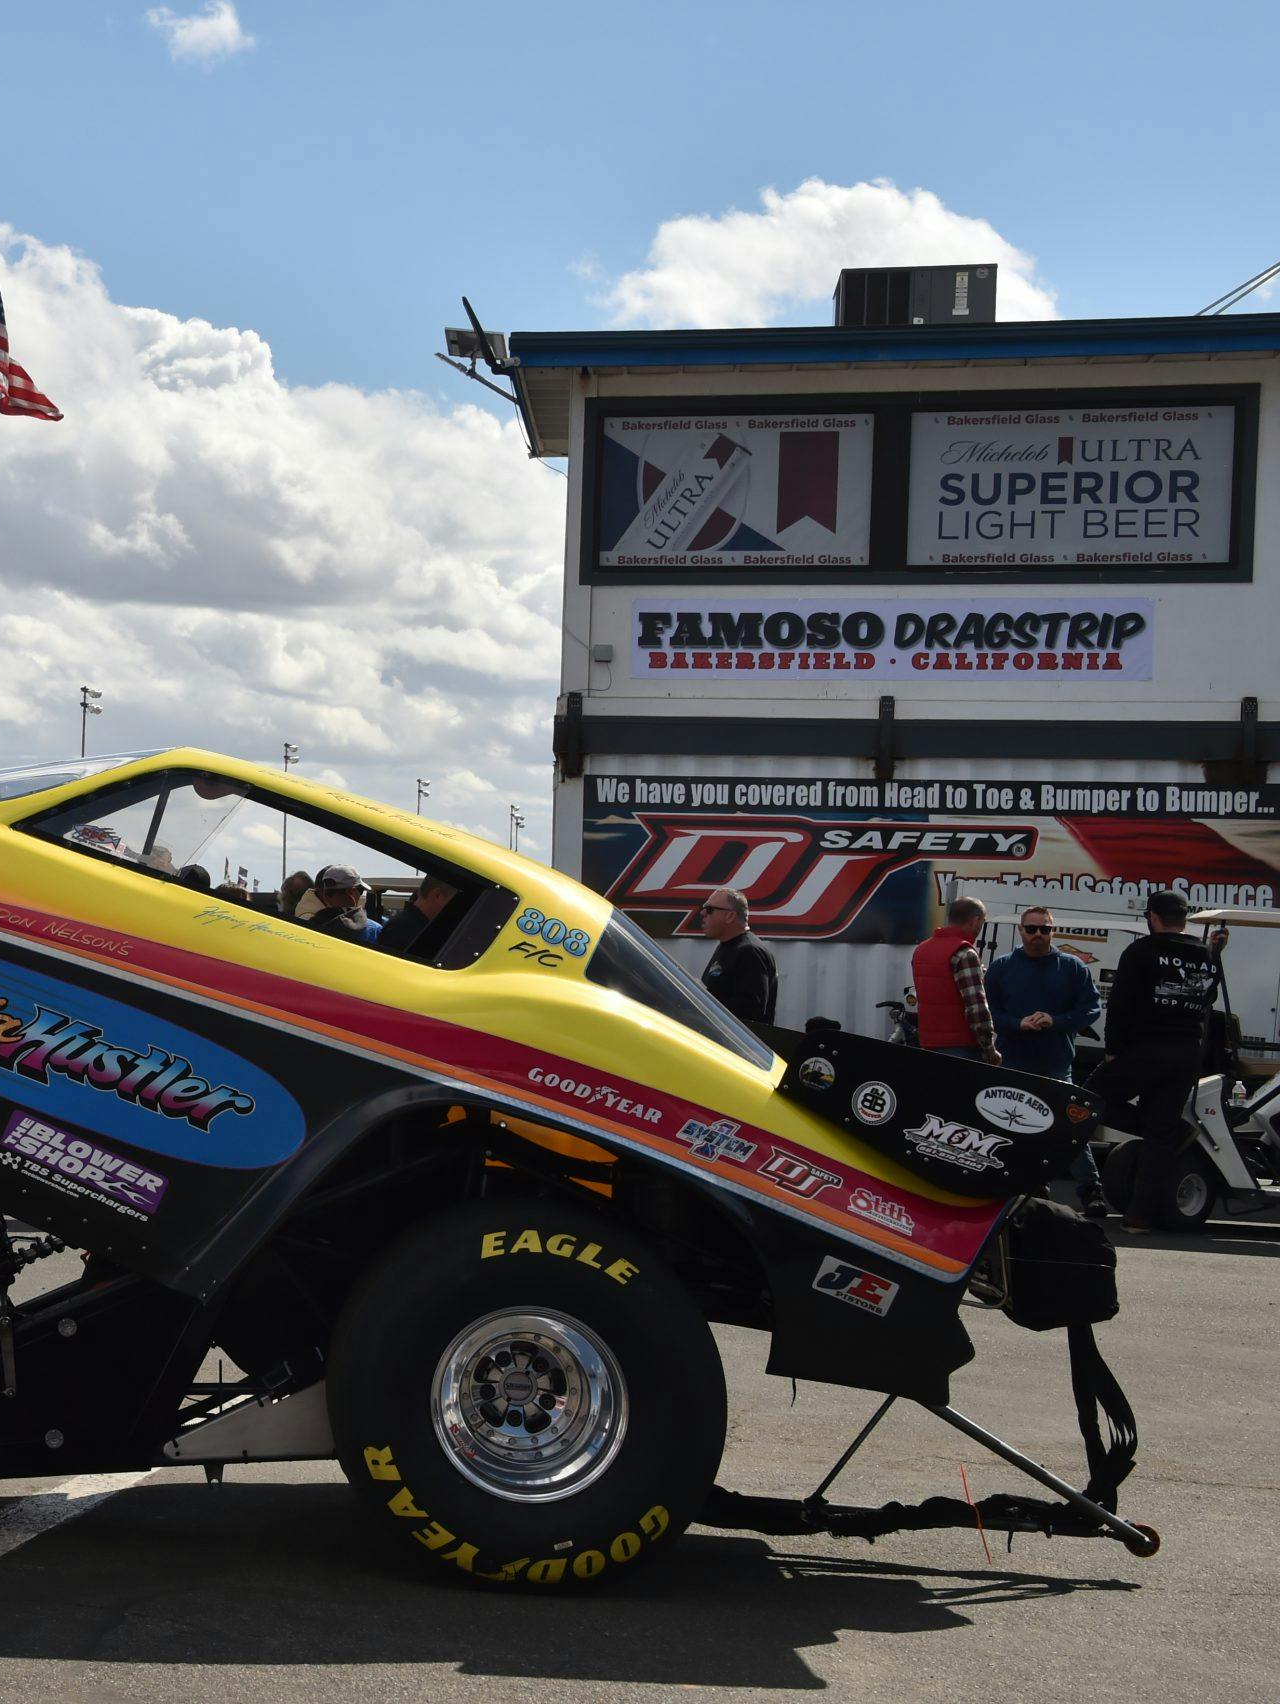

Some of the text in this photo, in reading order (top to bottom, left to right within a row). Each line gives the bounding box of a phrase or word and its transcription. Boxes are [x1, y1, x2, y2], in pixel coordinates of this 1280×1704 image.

[621, 419, 728, 431] Bakersfield Glass
[748, 417, 856, 430] Bakersfield Glass
[947, 413, 1060, 426] Bakersfield Glass
[1082, 411, 1198, 424] Bakersfield Glass
[939, 437, 1202, 465] Michelob ULTRA
[643, 471, 686, 530] Michelob
[937, 470, 1200, 506] SUPERIOR
[646, 472, 714, 550] ULTRA
[937, 508, 1200, 540] LIGHT BEER
[617, 554, 723, 566] Bakersfield Glass
[743, 553, 851, 566] Bakersfield Glass
[941, 552, 1055, 565] Bakersfield Glass
[1076, 551, 1193, 564] Bakersfield Glass
[637, 610, 1146, 650] FAMOSO DRAGSTRIP
[648, 651, 1124, 671] BAKERSFIELD CALIFORNIA
[596, 778, 1275, 815] We have you covered from Head to Toe & Bumper to Bumper...
[819, 830, 1028, 852] SAFETY
[1172, 877, 1273, 908] Source
[43, 919, 136, 956] NELSON'S
[516, 908, 590, 957] 808
[509, 942, 563, 967] F/C
[1159, 956, 1218, 973] NOMAD
[1154, 998, 1178, 1007] TOP
[528, 1067, 663, 1124] GOODYEAR
[984, 1088, 1025, 1105] ANTIQUE
[1024, 1098, 1050, 1117] AERO
[4, 1117, 35, 1145] THE
[682, 1121, 755, 1158] SYSTEM
[15, 1136, 106, 1182] SHOP
[25, 1122, 163, 1193] BLOWER
[810, 1167, 841, 1185] SAFETY
[23, 1160, 149, 1222] TBS Superchargers
[480, 1229, 640, 1285] EAGLE
[817, 1264, 892, 1306] JE
[835, 1290, 883, 1314] PISTONS
[363, 1445, 670, 1584] GOODYEAR
